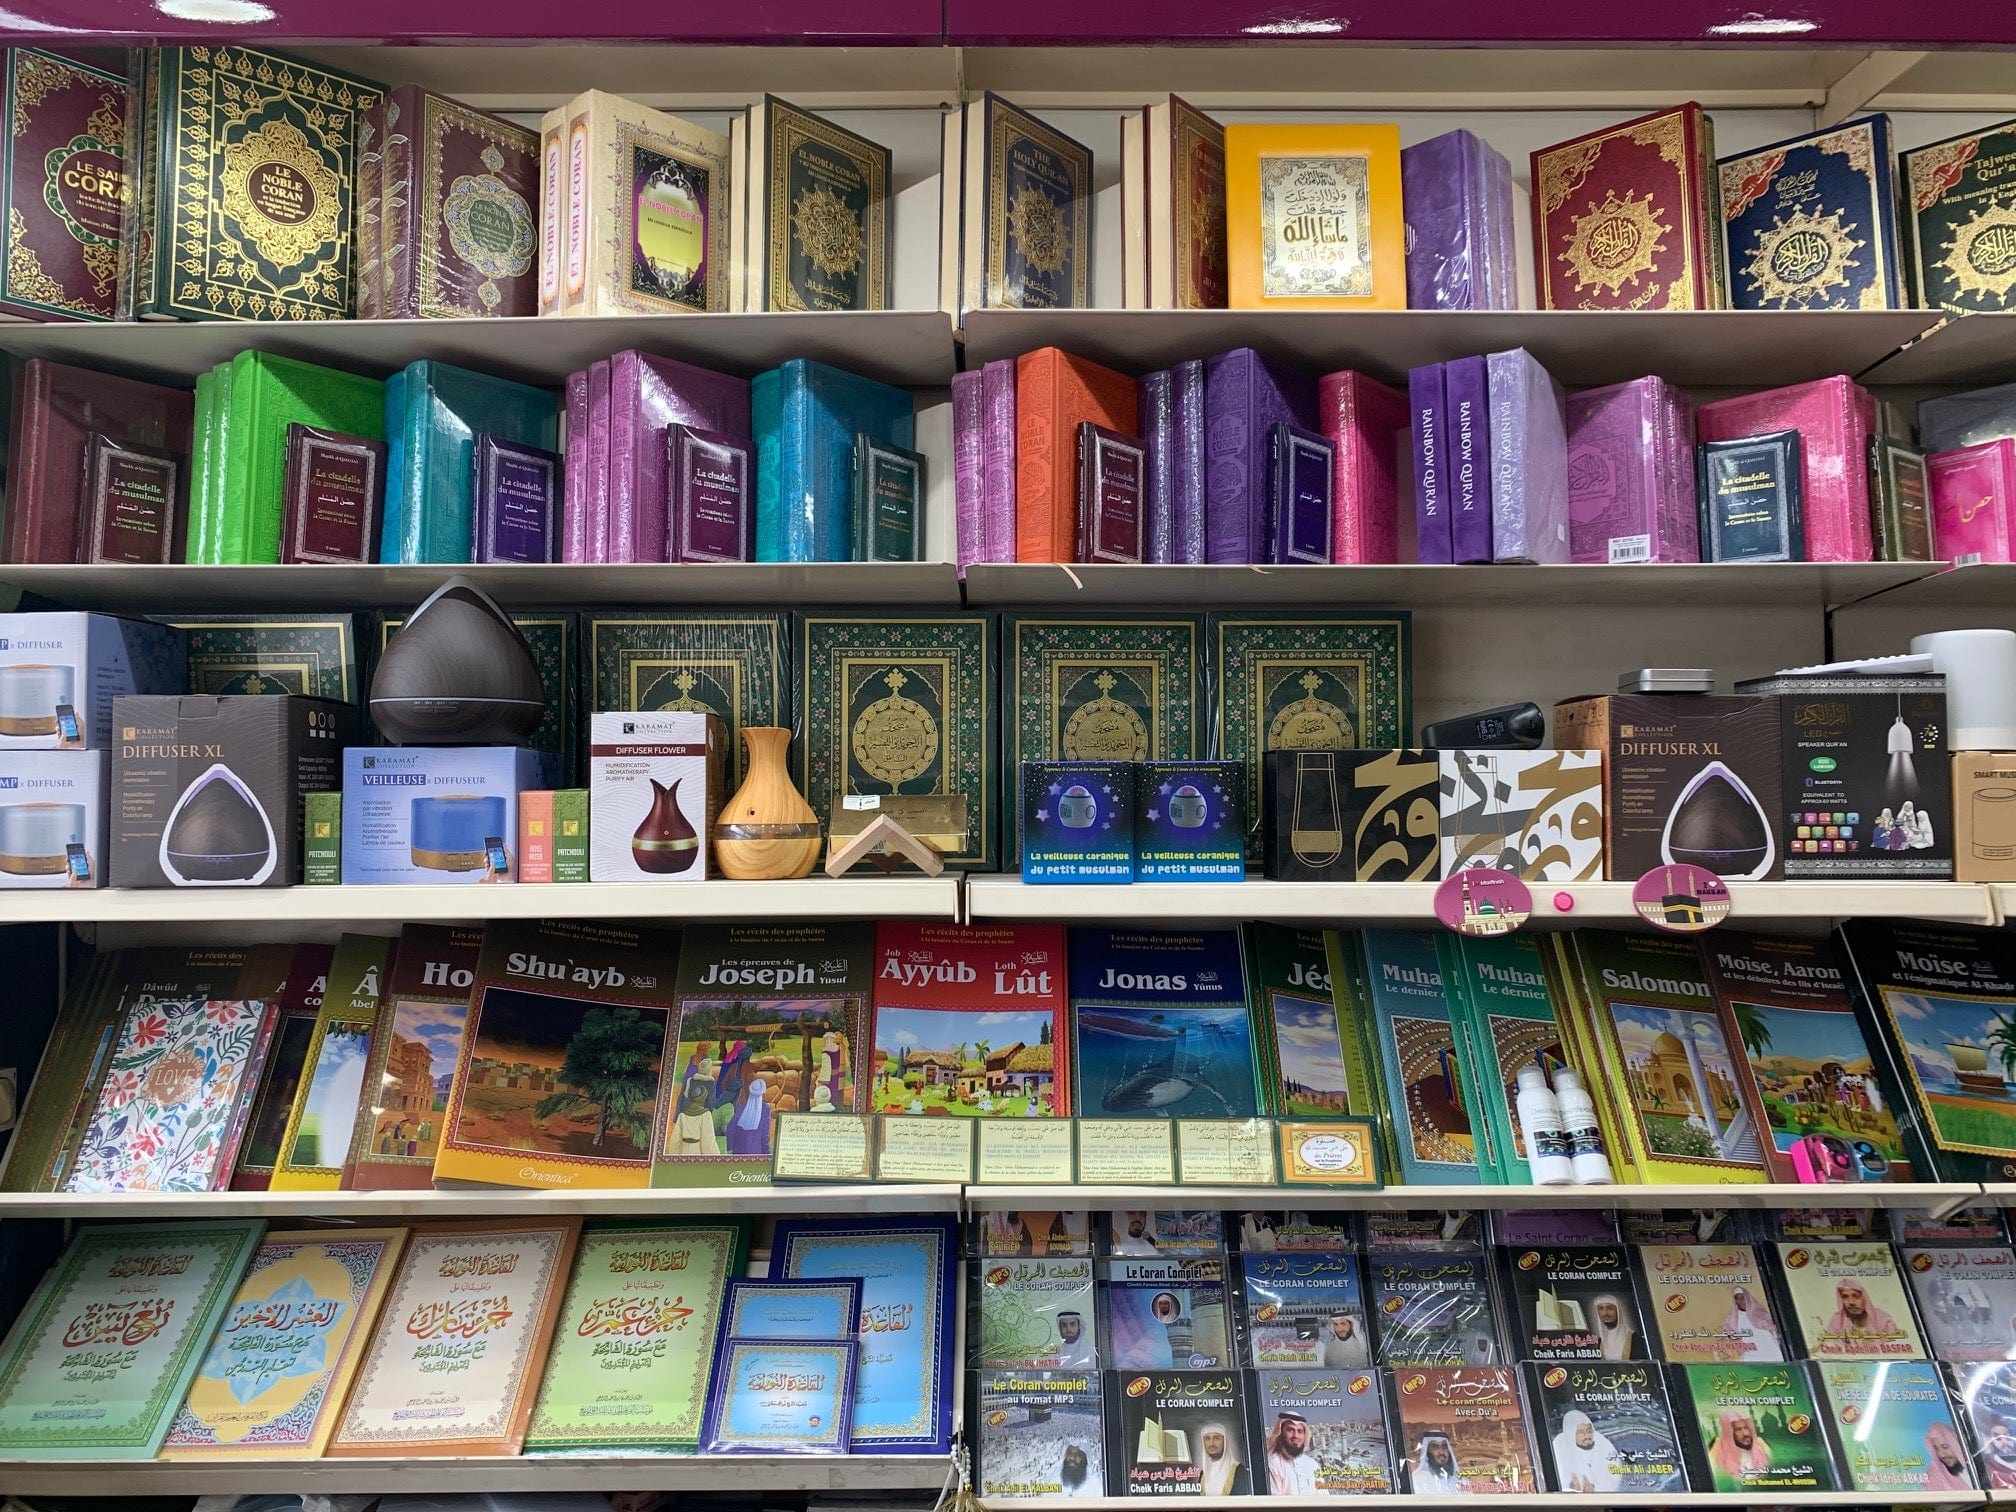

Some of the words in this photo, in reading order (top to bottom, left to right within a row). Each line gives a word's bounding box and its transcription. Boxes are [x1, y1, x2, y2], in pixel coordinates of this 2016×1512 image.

[1014, 150, 1037, 168] HOLY
[1033, 148, 1051, 165] THE
[275, 166, 291, 178] LE
[573, 138, 583, 196] CORAN
[809, 153, 835, 171] NOBLE
[835, 166, 861, 182] CORAN
[262, 173, 303, 192] NOBLE
[261, 184, 303, 203] CORAN
[1942, 195, 1962, 205] With
[1964, 184, 1998, 201] meaning
[470, 212, 510, 232] CORAN
[571, 200, 581, 257] NOBLE
[570, 259, 579, 278] EL
[1021, 426, 1046, 441] NOBLE
[1213, 426, 1241, 442] NOBLE
[1422, 408, 1434, 460] RAINBOW
[1460, 401, 1471, 456] RAINBOW
[1500, 401, 1510, 457] RAINBOW
[1020, 435, 1046, 453] CORAN
[1211, 434, 1242, 453] CORAN
[113, 477, 126, 488] La
[126, 480, 162, 496] citadelle
[502, 478, 512, 487] La
[512, 480, 542, 494] citadelle
[1461, 459, 1473, 512] QUR'AN
[1722, 478, 1733, 486] La
[1735, 472, 1770, 484] citadelle
[108, 486, 121, 497] du
[121, 487, 166, 505] musulman
[497, 486, 509, 495] du
[509, 488, 546, 502] musulman
[1424, 463, 1437, 517] QUR'AN
[1500, 460, 1511, 516] QUR'AN
[1718, 487, 1729, 495] du
[1731, 481, 1776, 494] musulman
[17, 641, 63, 650] DIFFUSER
[136, 728, 176, 736] KARAMAT
[1634, 726, 1675, 734] KARAMAT
[123, 745, 200, 759] DIFFUSER
[204, 744, 224, 758] XL
[1620, 743, 1699, 756] DIFFUSER
[1701, 743, 1722, 756] XL
[364, 775, 425, 785] VEILLEUSE
[434, 776, 486, 785] DIFFUSEUR
[309, 850, 336, 858] PATCHOULI
[1086, 853, 1130, 862] coranique
[1196, 853, 1240, 862] coranique
[1031, 864, 1044, 875] du
[1047, 864, 1077, 876] petit
[1079, 864, 1130, 875] musulman
[1141, 864, 1155, 875] du
[1157, 864, 1187, 876] petit
[1189, 864, 1240, 875] musulman
[1696, 888, 1727, 896] MAKKAH
[937, 928, 958, 936] récits
[976, 930, 1015, 939] prophètes
[885, 949, 901, 957] Job
[740, 958, 781, 968] épreuves
[995, 962, 1017, 970] Loth
[1717, 954, 1779, 976] Moïse,
[1784, 962, 1842, 979] Aaron
[1896, 950, 1969, 976] Moïse
[699, 964, 815, 990] Joseph
[879, 959, 977, 987] Ayyûb
[1100, 969, 1188, 990] Jonas
[1892, 972, 1903, 980] et
[142, 982, 178, 992] Dâwûd
[1602, 968, 1711, 998] Salomon
[1385, 985, 1398, 993] Le
[1400, 985, 1439, 998] dernier
[1482, 983, 1496, 993] Le
[1497, 986, 1547, 1000] dernier
[350, 999, 374, 1010] Abel
[155, 1068, 198, 1087] LOVE
[519, 1167, 574, 1184] Orientica
[1509, 1233, 1523, 1243] Le
[1525, 1233, 1551, 1242] Saint
[1557, 1233, 1588, 1243] Coran
[1126, 1265, 1137, 1279] Le
[1139, 1265, 1166, 1280] Coran
[1167, 1265, 1203, 1282] Complet
[1547, 1272, 1557, 1280] LE
[1559, 1272, 1585, 1280] CORAN
[1587, 1272, 1622, 1280] COMPLET
[1259, 1280, 1270, 1288] LE
[1273, 1280, 1305, 1288] CORAN
[1306, 1280, 1349, 1288] COMPLET
[1258, 1307, 1278, 1321] MP3
[1534, 1350, 1555, 1359] Cheik
[1556, 1350, 1574, 1358] Faris
[1575, 1350, 1602, 1358] ABBAD
[1193, 1355, 1217, 1371] mp3
[993, 1379, 1009, 1391] Le
[1010, 1378, 1042, 1391] Coran
[1044, 1378, 1088, 1392] complet
[1008, 1396, 1020, 1404] au
[1021, 1395, 1052, 1405] format
[1054, 1395, 1075, 1404] MP3
[1156, 1400, 1166, 1408] LE
[1167, 1400, 1195, 1408] CORAN
[1197, 1399, 1234, 1408] COMPLET
[1269, 1399, 1278, 1407] LE
[1280, 1399, 1305, 1407] CORAN
[1308, 1399, 1342, 1407] COMPLET
[1575, 1393, 1584, 1401] LE
[1586, 1393, 1612, 1402] CORAN
[1615, 1393, 1651, 1402] COMPLET
[1455, 1408, 1476, 1416] Avec
[1130, 1483, 1152, 1494] Cheik
[1154, 1483, 1174, 1494] Faris
[1175, 1483, 1202, 1493] ABBAD
